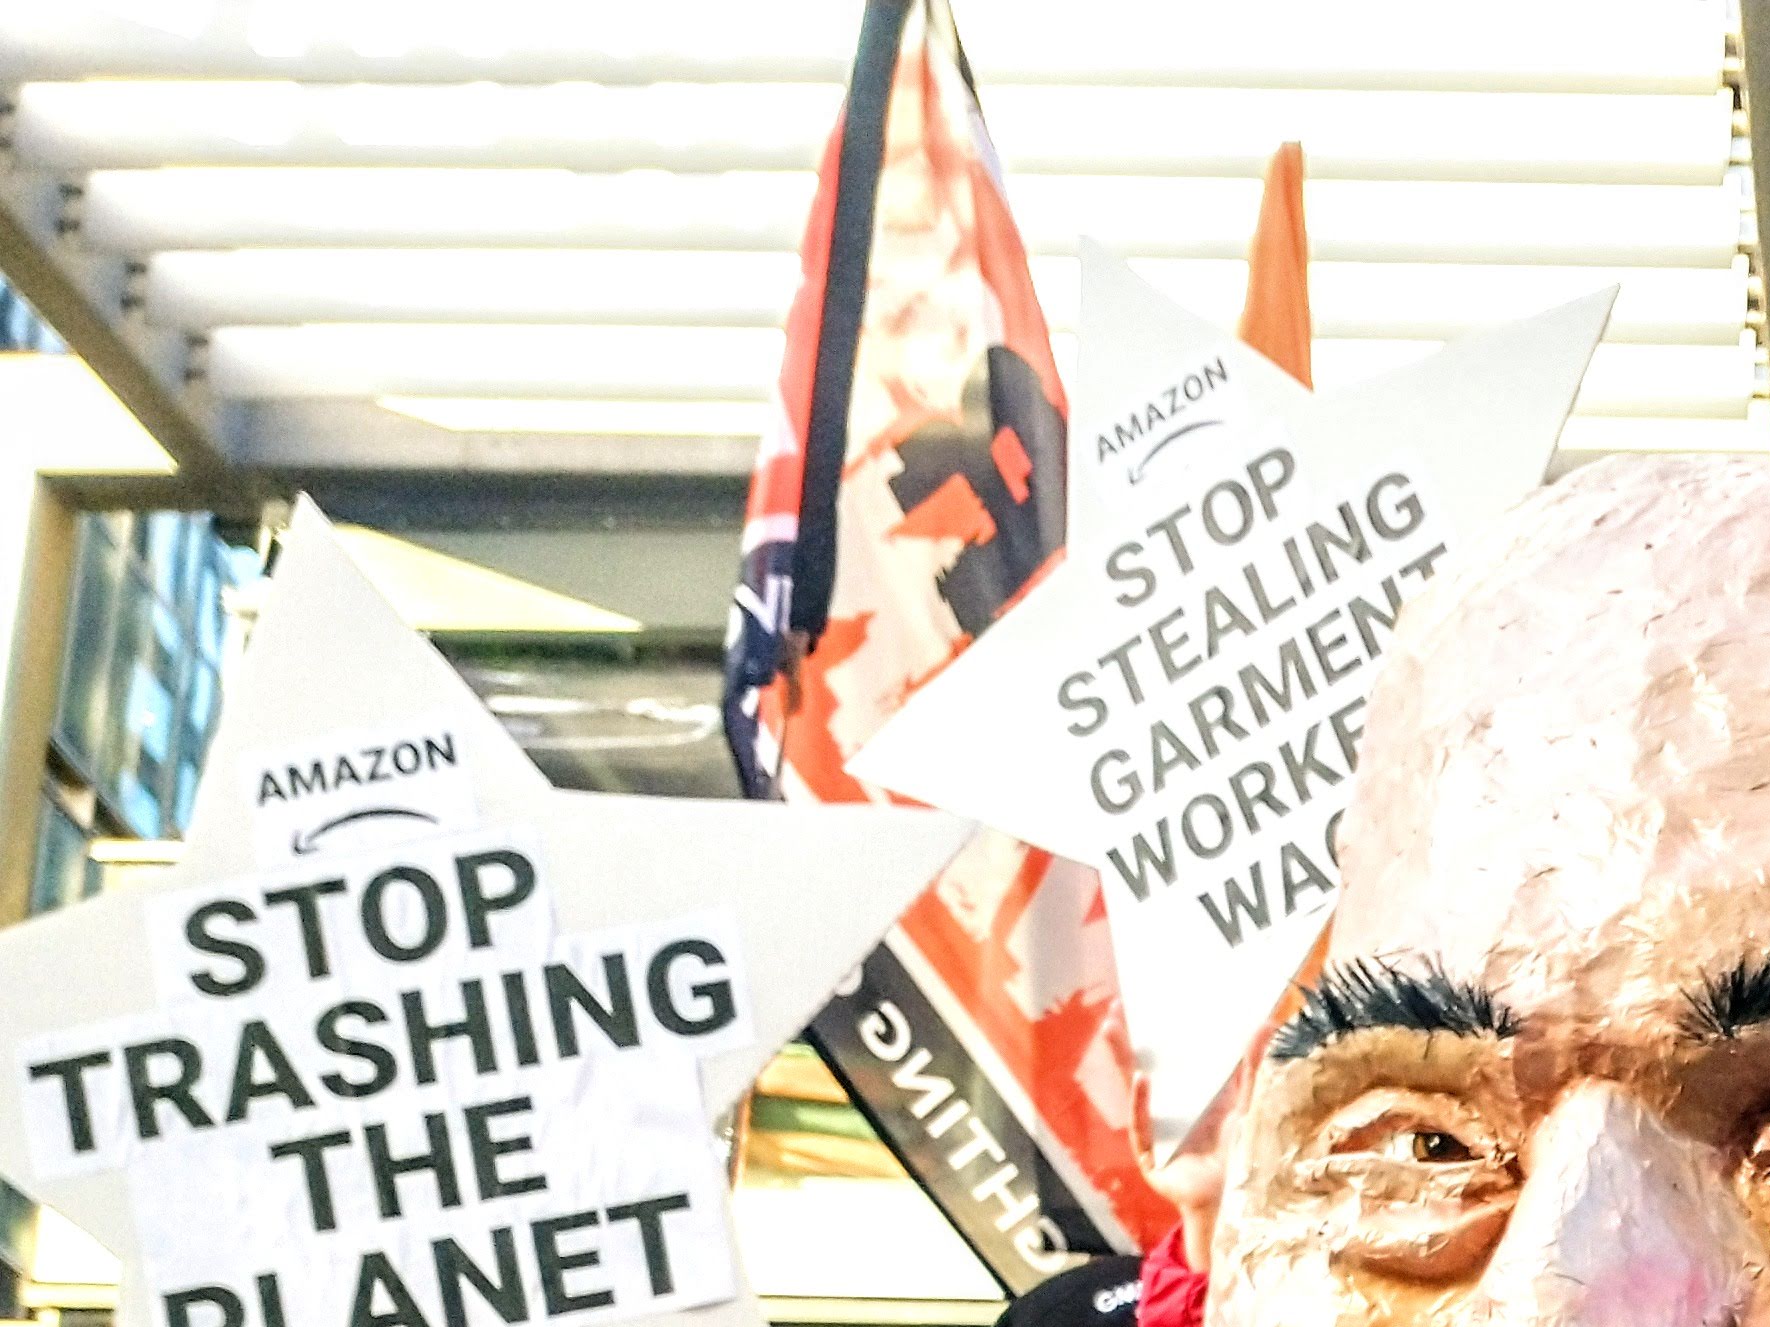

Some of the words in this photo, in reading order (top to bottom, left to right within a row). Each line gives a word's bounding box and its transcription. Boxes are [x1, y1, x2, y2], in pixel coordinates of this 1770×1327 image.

[1096, 355, 1231, 463] AMAZON
[1104, 446, 1297, 608] STOP
[1057, 472, 1426, 738] STEALING
[256, 733, 458, 806] AMAZON
[185, 849, 537, 998] STOP
[28, 937, 738, 1153] TRASHING
[269, 1095, 549, 1232] THE
